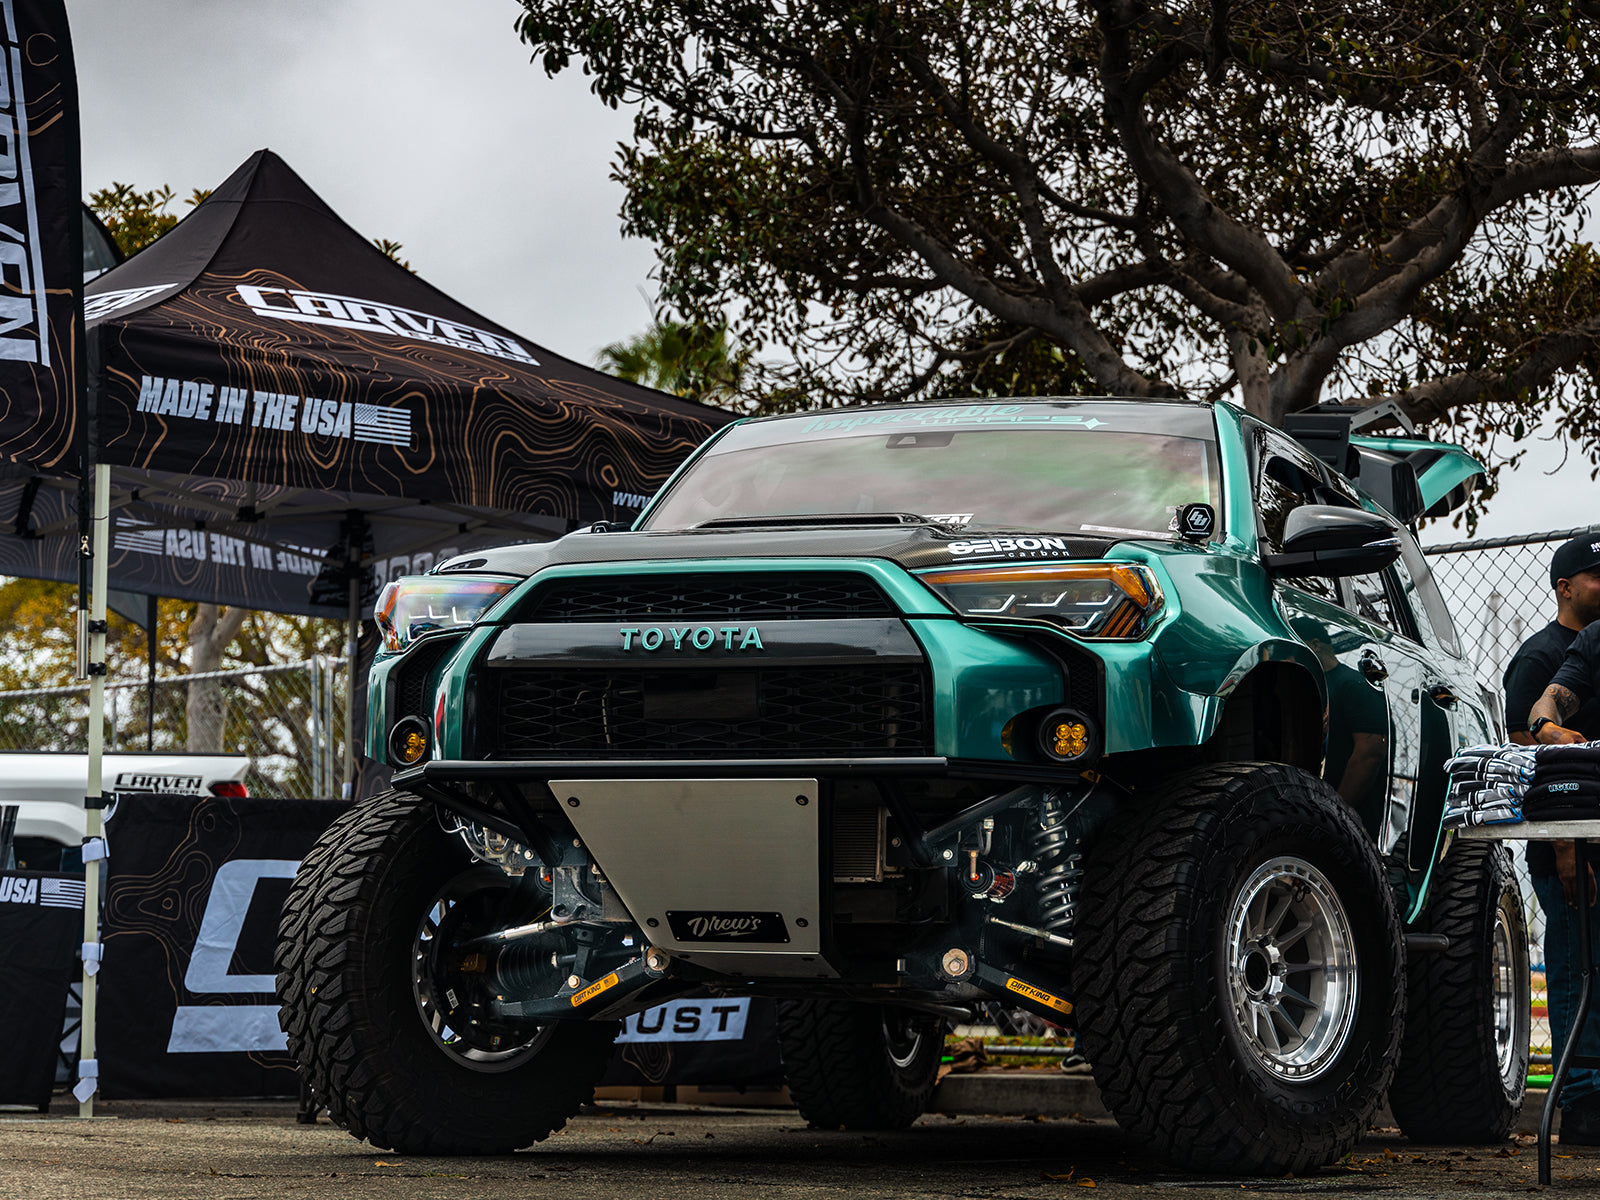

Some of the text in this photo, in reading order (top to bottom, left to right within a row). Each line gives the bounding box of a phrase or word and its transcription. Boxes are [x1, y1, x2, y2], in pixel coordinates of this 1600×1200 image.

[236, 285, 534, 358] CARVEN
[136, 375, 351, 438] MADE IN THE USA
[800, 405, 1025, 434] Impeccable
[947, 537, 1067, 556] SEBON
[1008, 550, 1070, 558] carbon
[620, 626, 763, 650] TOYOTA
[114, 772, 203, 793] CARVEN
[1548, 782, 1580, 792] LEGEND
[0, 876, 38, 904] USA
[687, 914, 762, 937] Drew's
[1010, 980, 1031, 992] DIRT
[1029, 988, 1051, 1002] KING
